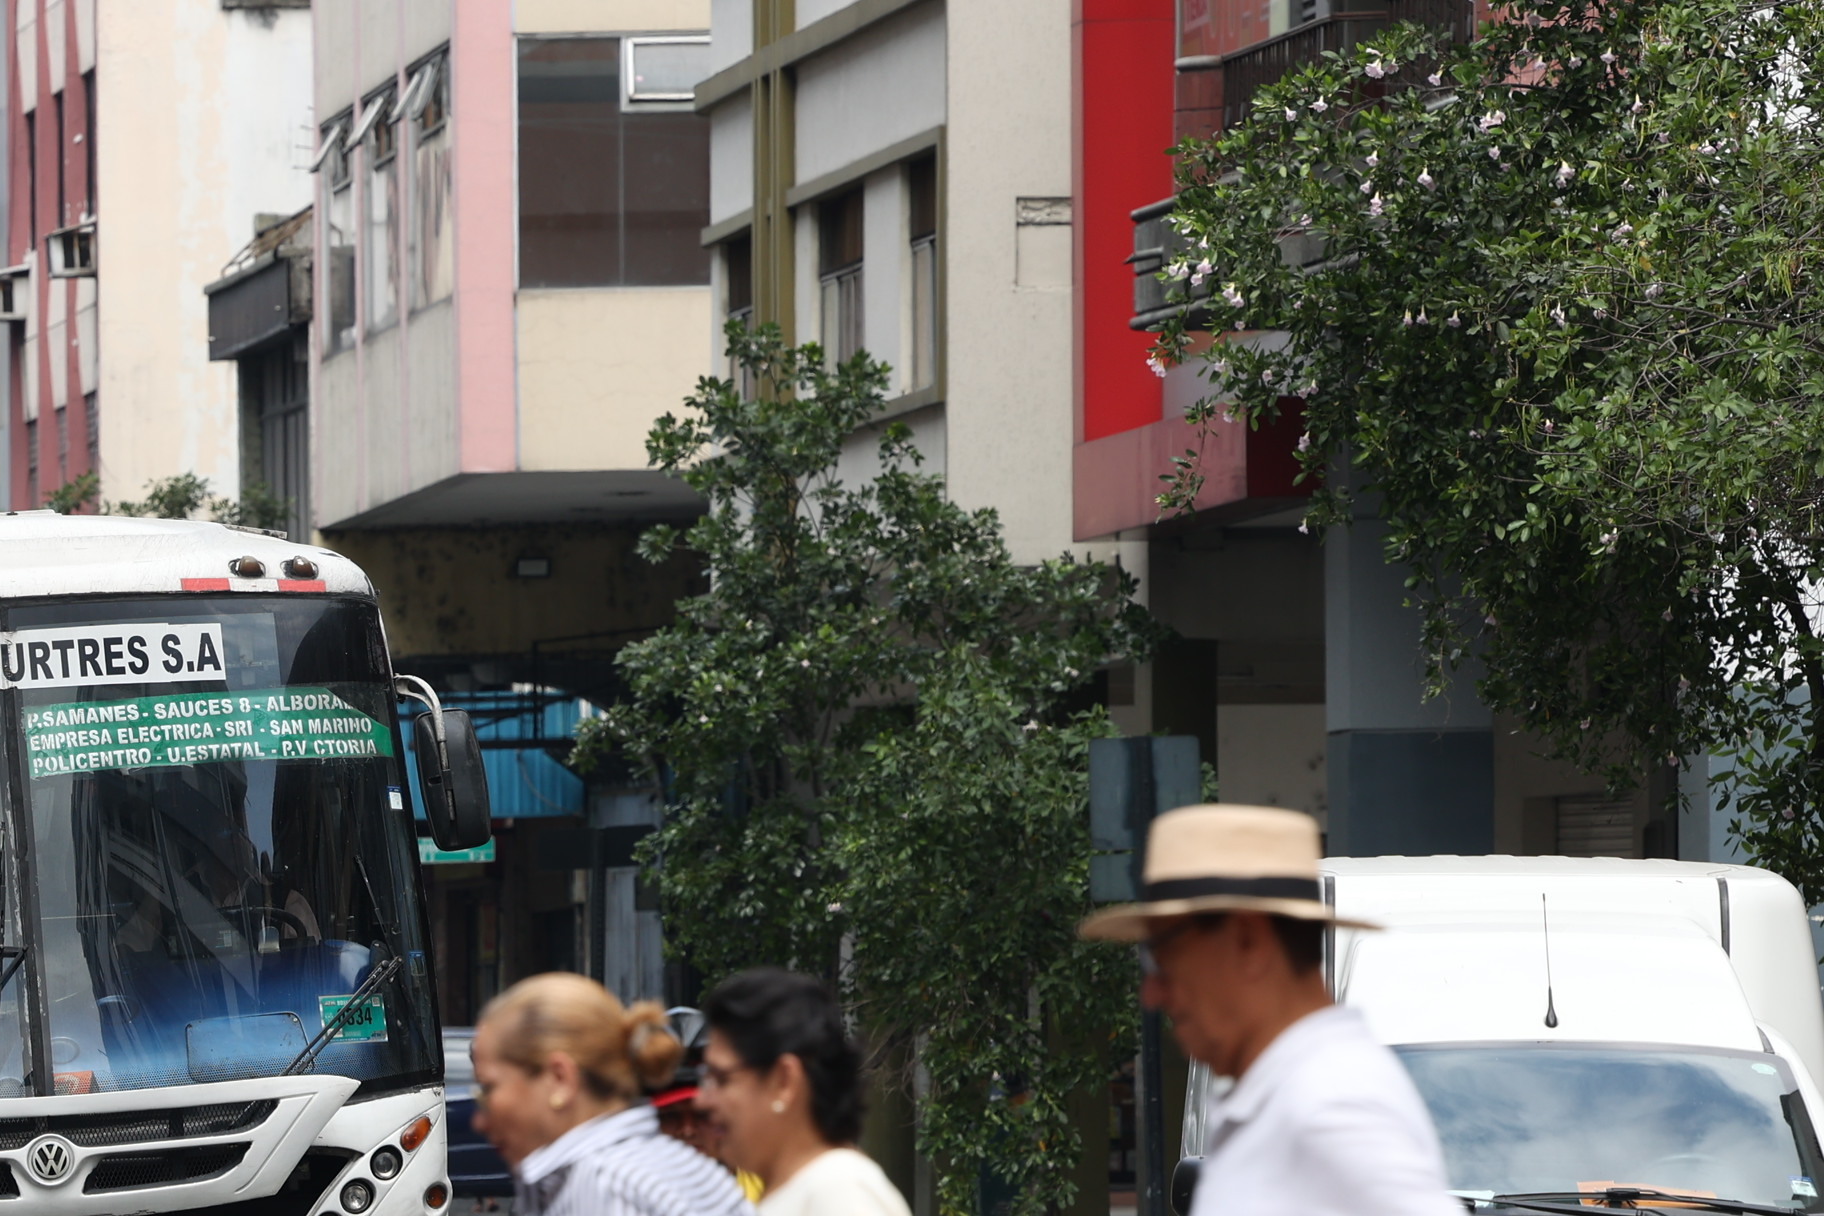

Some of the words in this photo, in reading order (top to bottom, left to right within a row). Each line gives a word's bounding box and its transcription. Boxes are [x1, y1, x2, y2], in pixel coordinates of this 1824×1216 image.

[161, 632, 222, 672] S.A
[27, 704, 139, 728] P.SAMANES
[154, 698, 233, 719] SAUCES
[240, 698, 251, 713] 8
[30, 729, 113, 749] EMPRESA
[224, 720, 253, 737] SRI
[269, 719, 303, 736] SAN
[308, 717, 373, 735] MARINO
[33, 748, 152, 773] POLICENTRO
[167, 743, 266, 763] U.ESTATAL
